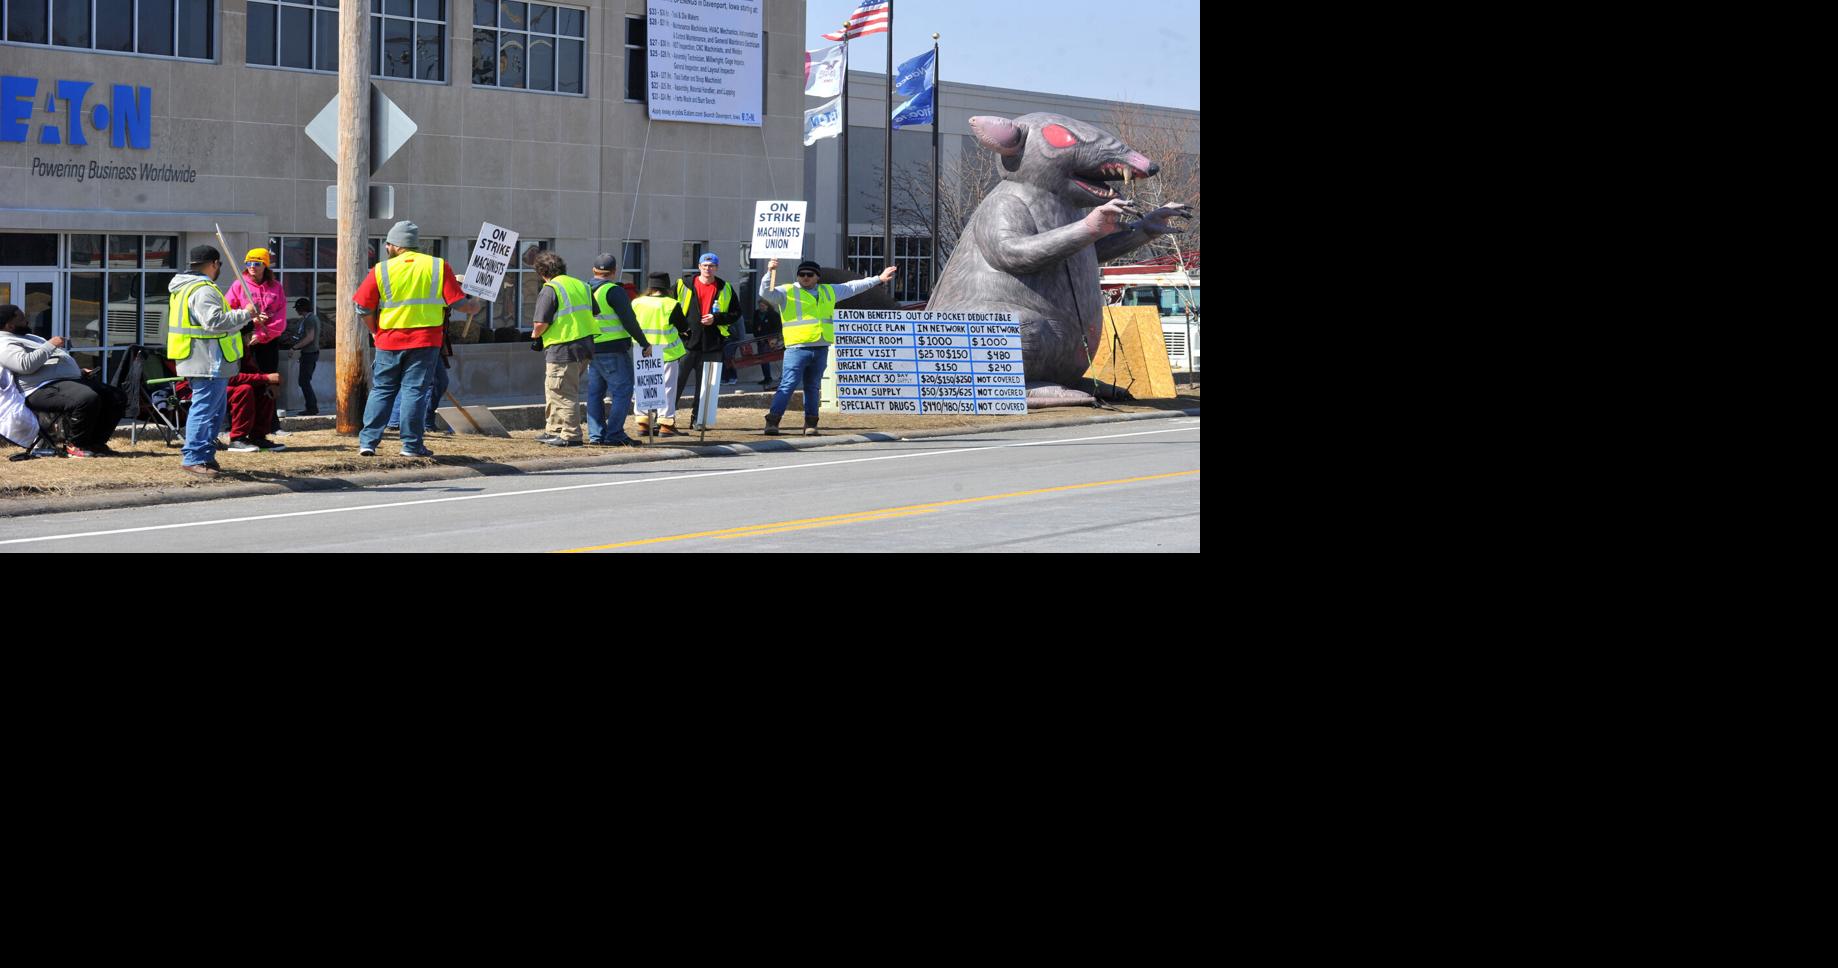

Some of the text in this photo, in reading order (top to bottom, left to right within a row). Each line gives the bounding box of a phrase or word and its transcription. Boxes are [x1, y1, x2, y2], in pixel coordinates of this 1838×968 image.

[0, 76, 152, 150] EATON
[32, 157, 196, 183] Powering Business Worldwide
[770, 203, 788, 212] ON
[759, 213, 800, 222] STRIKE
[493, 229, 507, 241] ON
[757, 227, 800, 237] MACHINISTS
[480, 239, 511, 256] STRIKE
[766, 239, 788, 248] UNION
[472, 255, 505, 275] MACHINISTS
[476, 271, 494, 287] UNION
[839, 312, 864, 320] EATON
[868, 312, 901, 320] BENEFITS
[937, 312, 965, 321] POCKET
[968, 313, 1011, 322] DEDUCTIBLE
[987, 326, 1020, 335] NETWORK
[836, 336, 876, 345] EMERGENCY
[879, 336, 903, 345] ROOM
[918, 337, 952, 346] $1000
[837, 349, 1010, 360] OFFICE VISIT $25 TO $150 $480
[636, 359, 661, 370] STRIKE
[838, 362, 1012, 372] URGENT CARE $150 $240
[637, 374, 663, 386] MACHINISTS
[884, 375, 895, 384] 30
[921, 374, 972, 385] $20/$150/$250
[643, 388, 658, 399] UNION
[840, 387, 851, 395] 90
[853, 387, 867, 395] DAY
[871, 387, 901, 396] SUPPLY
[921, 386, 972, 397] $50/$375/625
[994, 388, 1023, 396] COVERED
[841, 402, 885, 410] SPECIALTY
[889, 402, 916, 411] DRUGS
[978, 402, 992, 410] NOT
[995, 402, 1024, 411] COVERED
